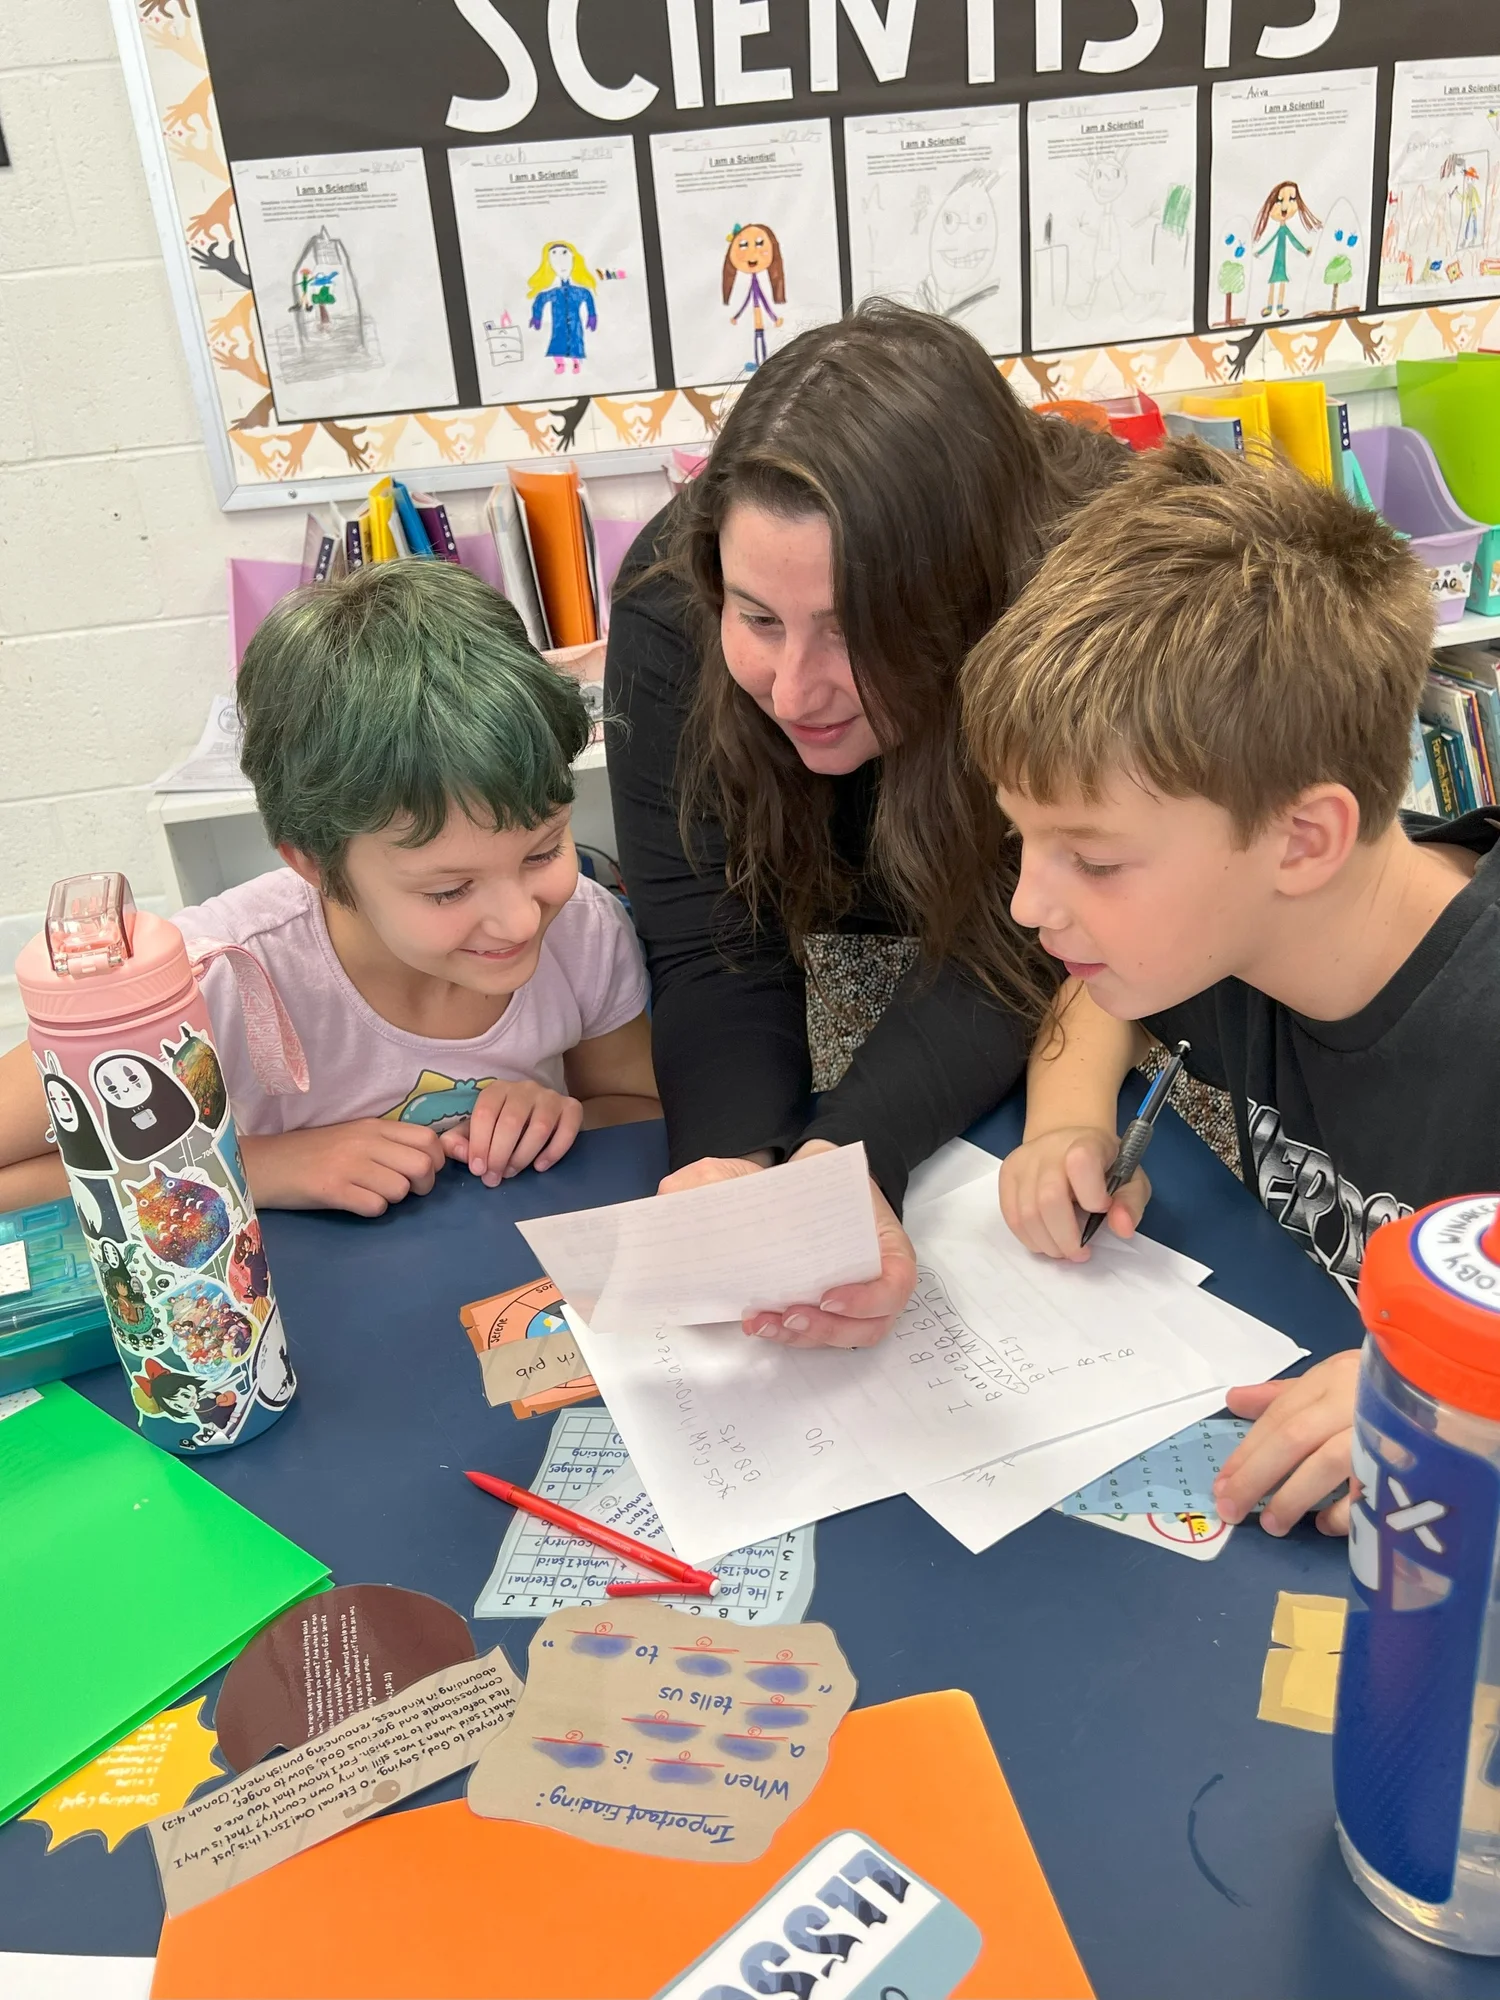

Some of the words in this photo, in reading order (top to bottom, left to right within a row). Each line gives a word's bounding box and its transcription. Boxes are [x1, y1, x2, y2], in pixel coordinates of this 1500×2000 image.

[1247, 85, 1269, 100] Aviva
[1468, 84, 1500, 93] Scientist
[1268, 105, 1281, 113] am
[1289, 100, 1324, 111] Scientist!
[1107, 120, 1144, 131] Scientist!
[906, 141, 919, 149] am
[714, 158, 729, 166] am
[515, 174, 529, 182] am
[301, 187, 316, 195] am
[548, 1462, 582, 1474] anger,
[585, 1467, 597, 1477] to
[606, 1493, 647, 1523] embryos.
[626, 1508, 649, 1525] from
[633, 1526, 645, 1536] to
[534, 1535, 593, 1548] country?
[535, 1557, 565, 1566] said
[577, 1558, 609, 1568] what
[782, 1550, 794, 1561] 3
[508, 1575, 556, 1587] Eternal
[779, 1570, 789, 1581] 2
[502, 1595, 515, 1606] J
[747, 1587, 767, 1601] He
[553, 1599, 564, 1608] H
[690, 1606, 701, 1615] C
[719, 1608, 729, 1618] B
[748, 1609, 758, 1620] A
[634, 1644, 659, 1665] to
[437, 1667, 496, 1694] abounding
[420, 1677, 503, 1716] compassionate
[425, 1692, 437, 1702] in
[488, 1687, 510, 1700] fled
[658, 1686, 684, 1702] us
[371, 1697, 425, 1722] kindness,
[488, 1697, 516, 1712] what
[689, 1690, 733, 1715] tells
[398, 1714, 419, 1726] and
[425, 1699, 485, 1728] beforehand
[458, 1713, 480, 1728] said
[410, 1725, 423, 1736] to
[426, 1725, 456, 1739] when
[467, 1712, 504, 1737] prayed
[305, 1722, 371, 1756] renouncing
[346, 1722, 396, 1750] gracious
[453, 1733, 465, 1743] to
[359, 1733, 409, 1756] Tarshish.
[393, 1743, 416, 1756] was
[421, 1740, 450, 1756] God,
[789, 1743, 805, 1758] a
[315, 1748, 345, 1769] God,
[338, 1756, 358, 1769] For
[371, 1753, 390, 1768] still
[613, 1750, 634, 1770] is
[230, 1753, 304, 1794] punishment.
[287, 1764, 315, 1781] slow
[357, 1764, 367, 1775] in
[273, 1778, 286, 1788] to
[298, 1771, 330, 1792] know
[338, 1771, 355, 1784] my
[309, 1783, 335, 1799] own
[724, 1772, 791, 1801] When
[232, 1785, 271, 1808] anger,
[271, 1787, 296, 1804] that
[317, 1785, 357, 1810] Eternal
[534, 1784, 621, 1822] Finding:
[188, 1792, 229, 1818] (Jonah
[247, 1801, 270, 1816] You
[255, 1797, 307, 1828] country?
[161, 1815, 185, 1831] 4:2)
[224, 1814, 244, 1827] are
[290, 1808, 315, 1823] One!
[262, 1820, 291, 1839] Isn't
[625, 1803, 735, 1845] Important
[223, 1825, 253, 1842] That
[211, 1840, 223, 1848] is
[238, 1838, 261, 1850] this
[184, 1846, 210, 1862] why
[211, 1844, 235, 1865] just
[173, 1859, 183, 1869] I
